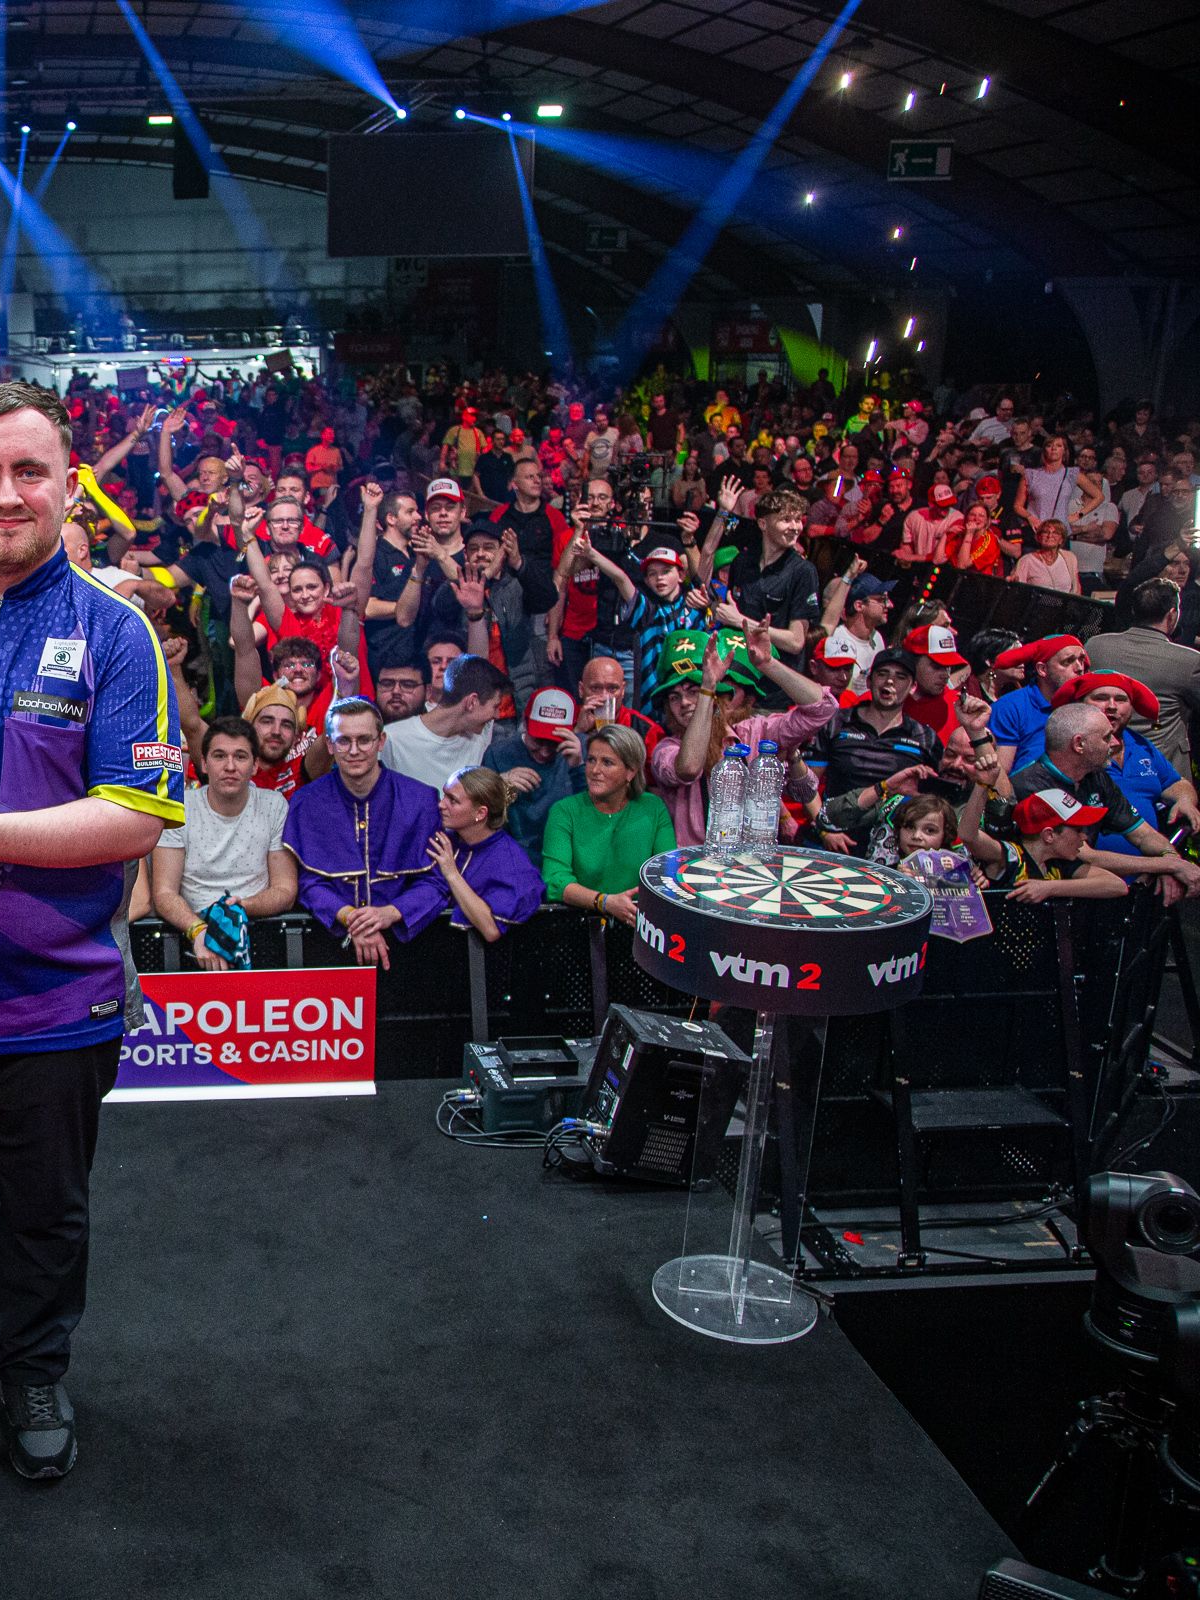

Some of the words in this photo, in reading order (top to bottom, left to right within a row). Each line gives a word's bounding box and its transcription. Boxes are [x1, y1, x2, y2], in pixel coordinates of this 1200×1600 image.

[18, 697, 84, 717] boohooMAN
[136, 746, 180, 762] PRESTIGE
[941, 887, 971, 897] LITTLER
[668, 934, 686, 963] 2
[709, 950, 790, 988] vtm
[797, 962, 822, 990] 2
[867, 949, 919, 987] vtm
[123, 997, 363, 1037] APOLEON
[118, 1042, 212, 1067] PORTS
[220, 1041, 242, 1064] &
[249, 1037, 365, 1063] CASINO
